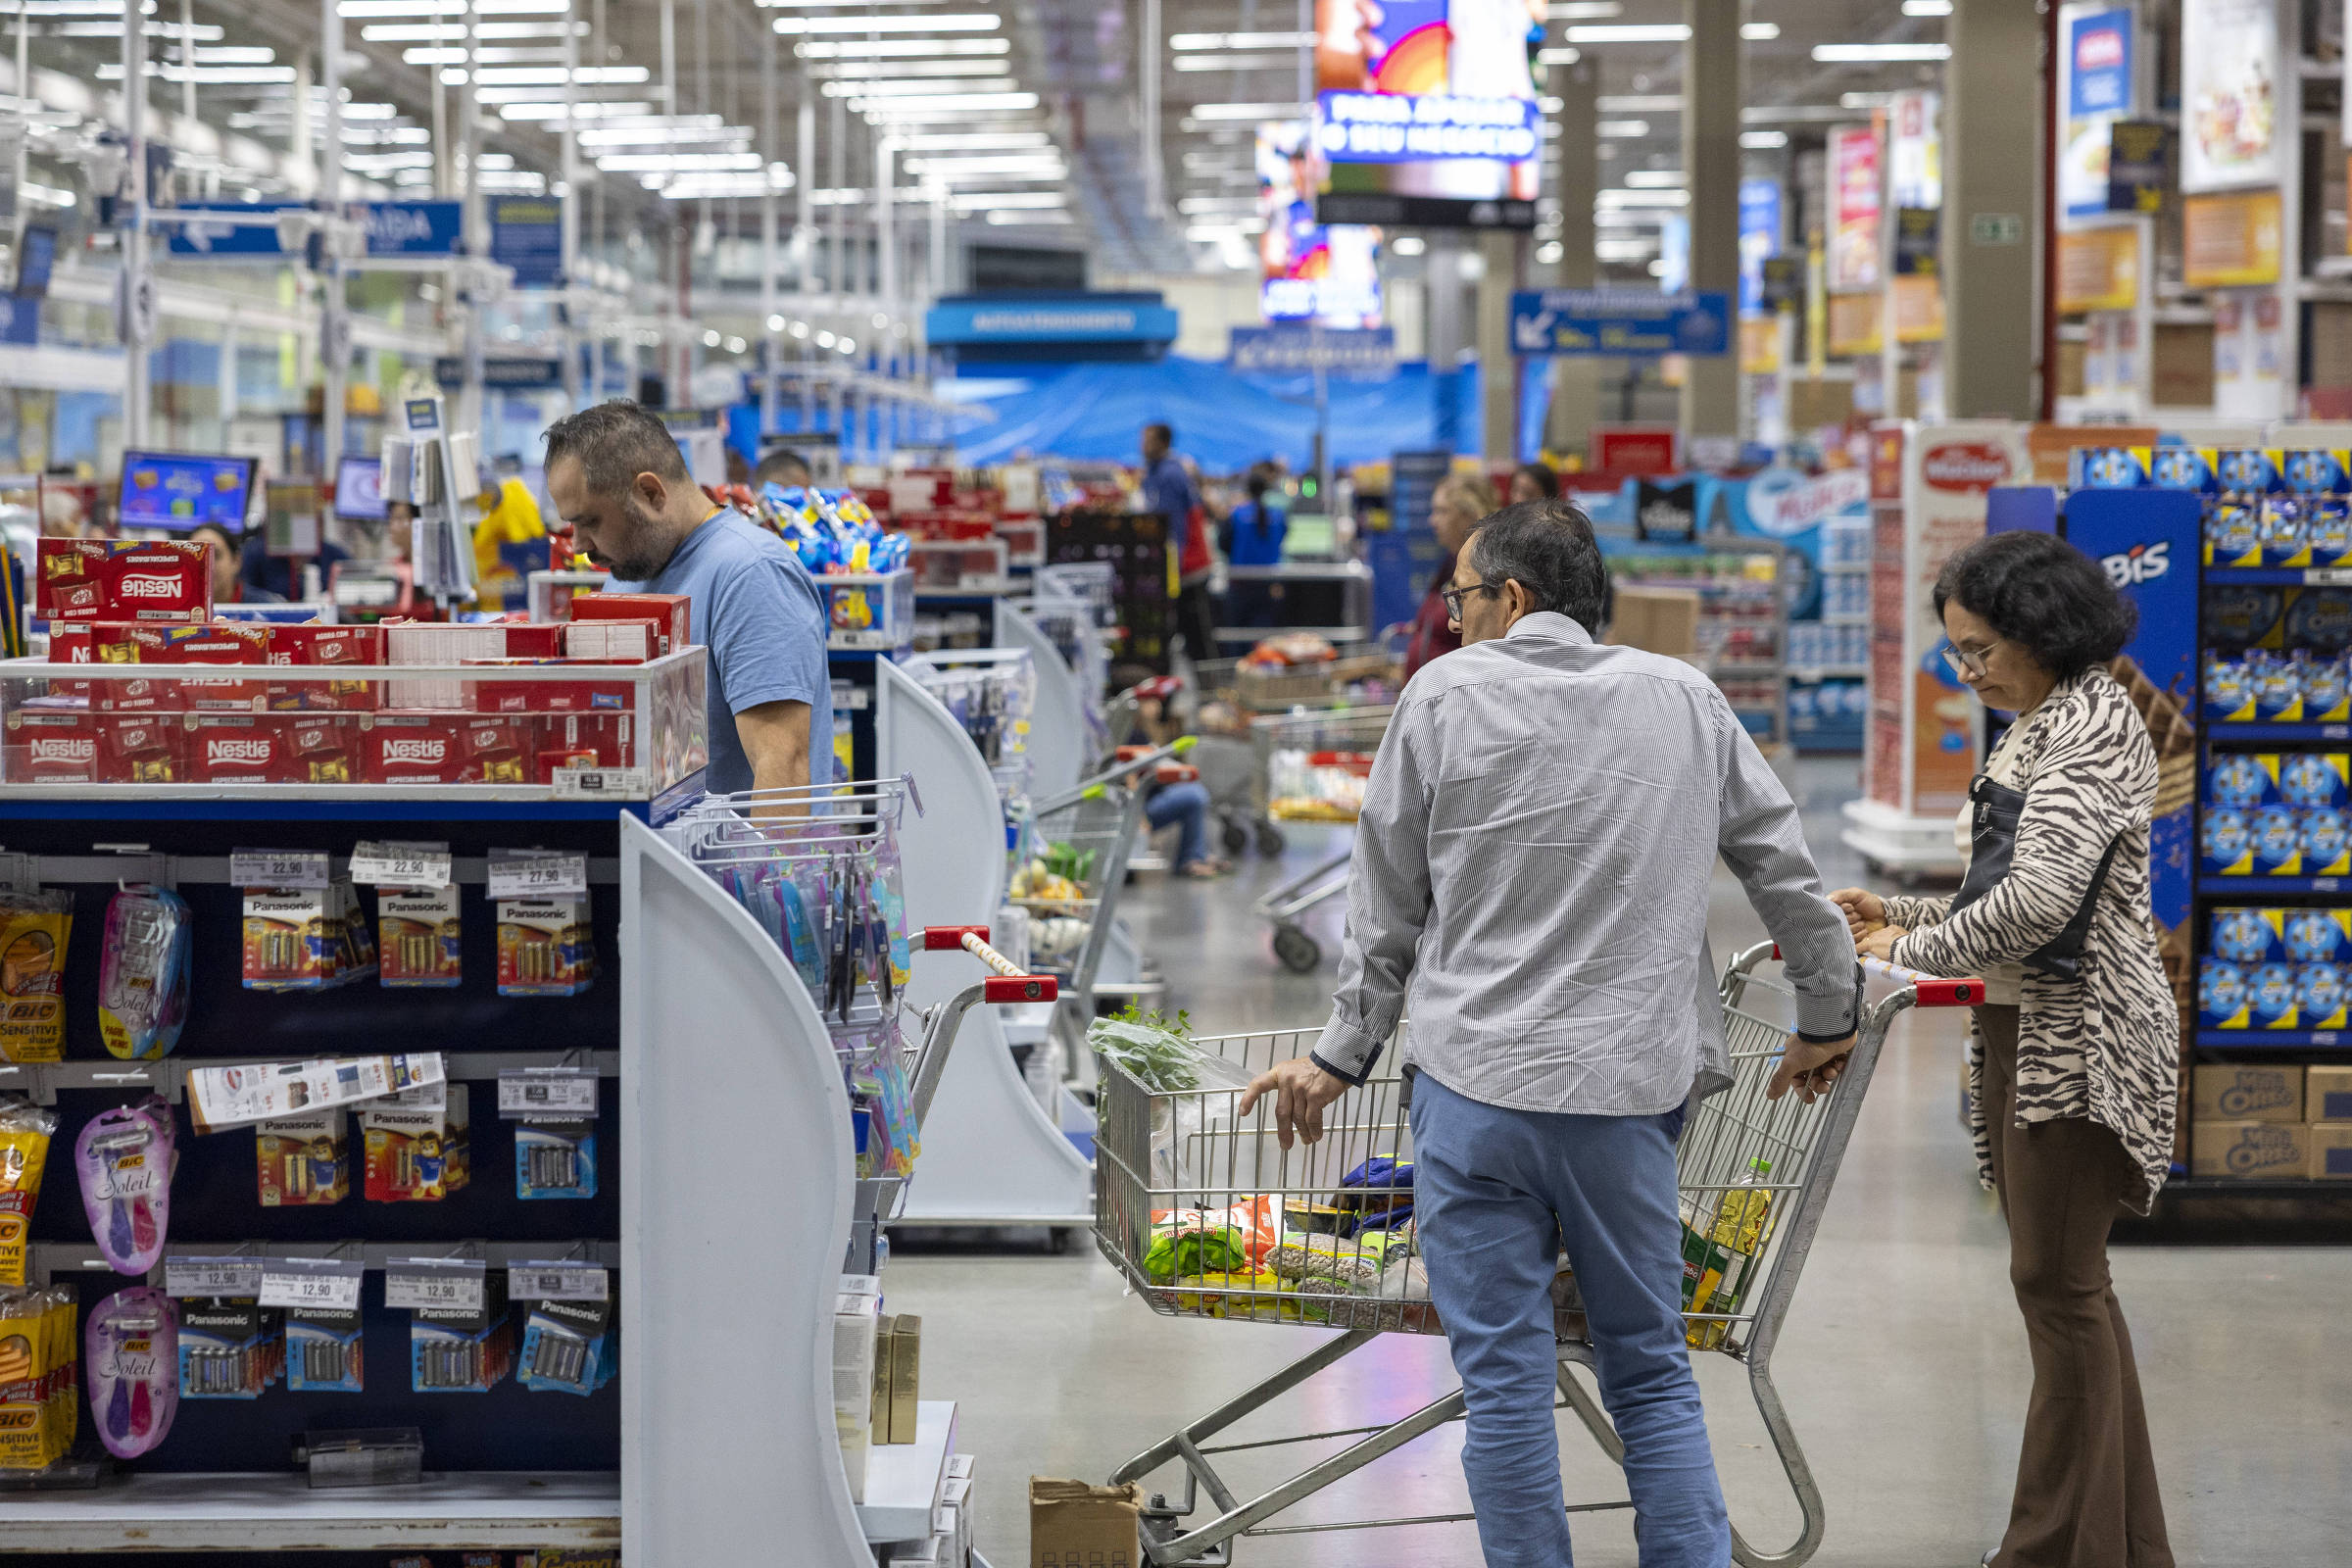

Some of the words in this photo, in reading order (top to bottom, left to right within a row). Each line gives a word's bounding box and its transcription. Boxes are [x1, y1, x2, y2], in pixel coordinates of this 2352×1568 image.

[121, 579, 182, 598] Nestlé
[30, 739, 94, 757] Nestlé
[208, 740, 270, 758] Nestlé
[382, 740, 446, 758] Nestlé
[253, 901, 314, 911] Panasonic
[388, 903, 448, 912] Panasonic
[507, 908, 566, 918] Panasonic
[108, 989, 150, 1011] Soleil
[13, 1004, 53, 1019] BIC
[0, 1025, 58, 1036] SENSITIVE
[373, 1113, 433, 1124] Panasonic
[265, 1120, 326, 1130] Panasonic
[119, 1155, 144, 1168] BIC
[94, 1171, 153, 1200] Soleil
[294, 1308, 354, 1319] Panasonic
[419, 1308, 479, 1319] Panasonic
[541, 1299, 602, 1322] Panasonic
[186, 1314, 248, 1325] Panasonic
[125, 1341, 150, 1351] BIC
[99, 1351, 156, 1378] Soleil
[0, 1433, 39, 1443] NSITIVE
